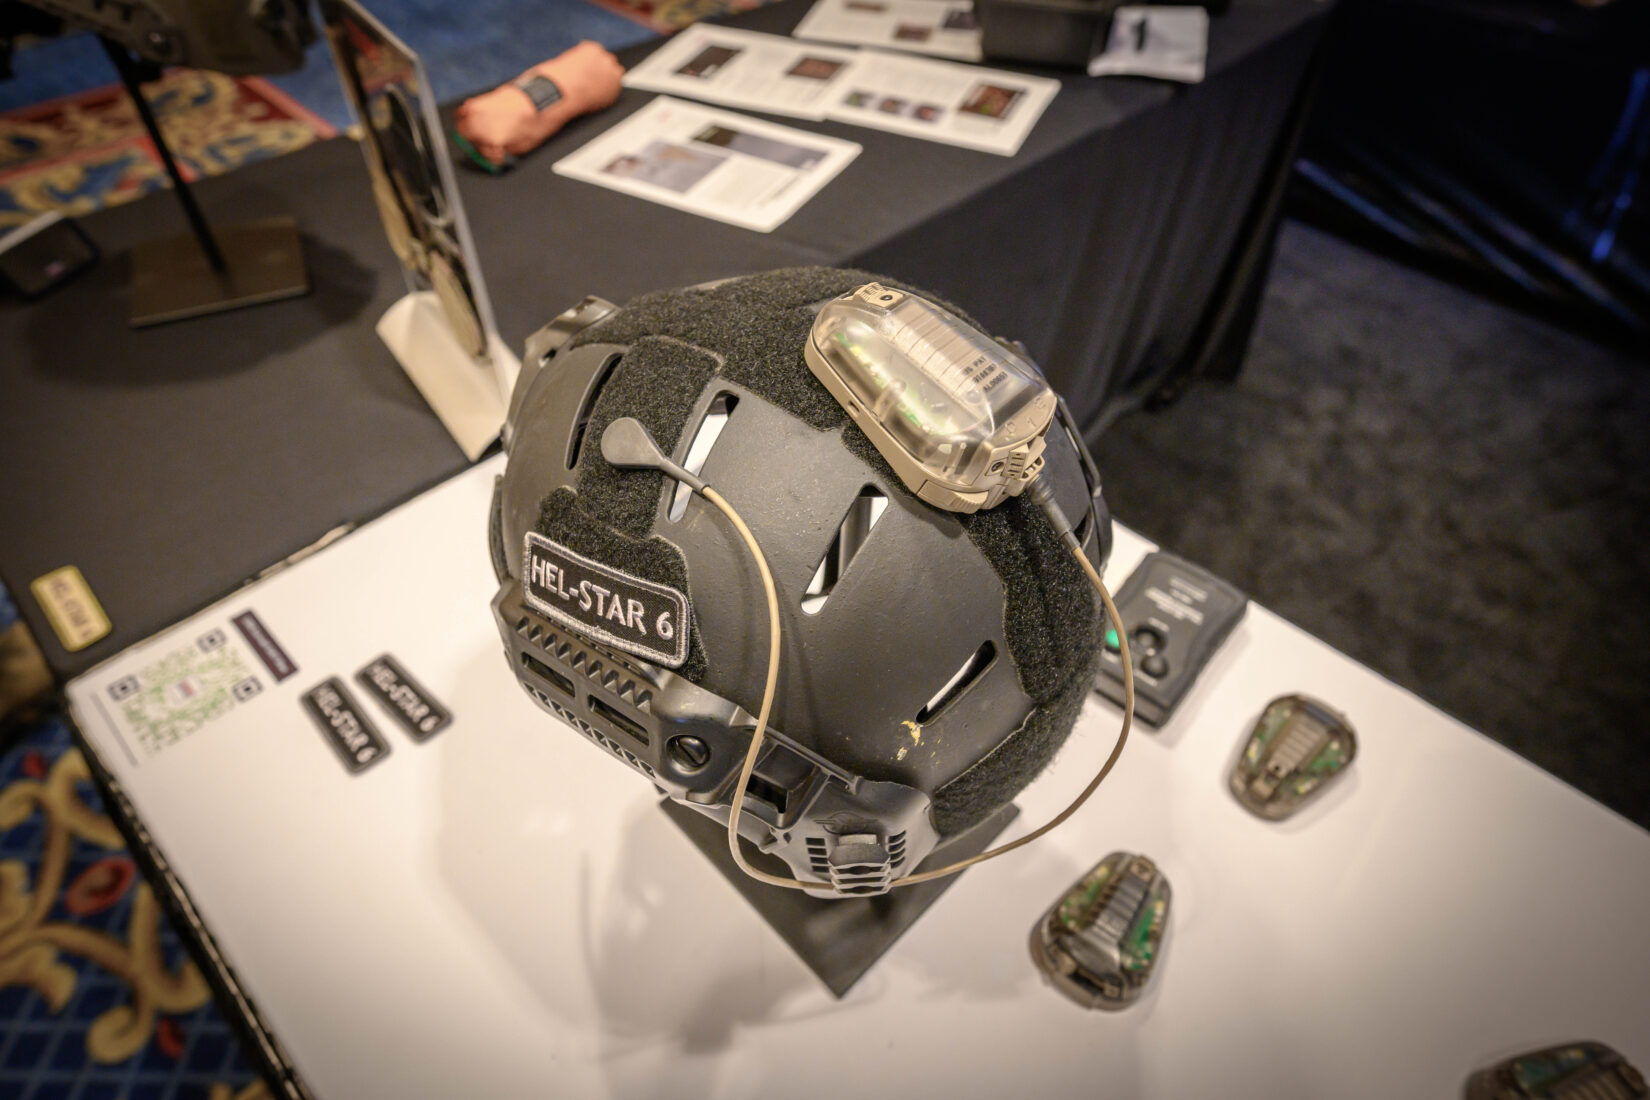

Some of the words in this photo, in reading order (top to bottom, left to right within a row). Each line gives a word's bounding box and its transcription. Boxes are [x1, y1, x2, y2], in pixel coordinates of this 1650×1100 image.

[531, 555, 647, 635] HEL-STAR
[656, 611, 673, 640] 6
[312, 683, 369, 752] HEL-STAR
[356, 747, 378, 763] 6
[366, 663, 430, 723] HEL-STAR
[419, 715, 440, 732] 6
